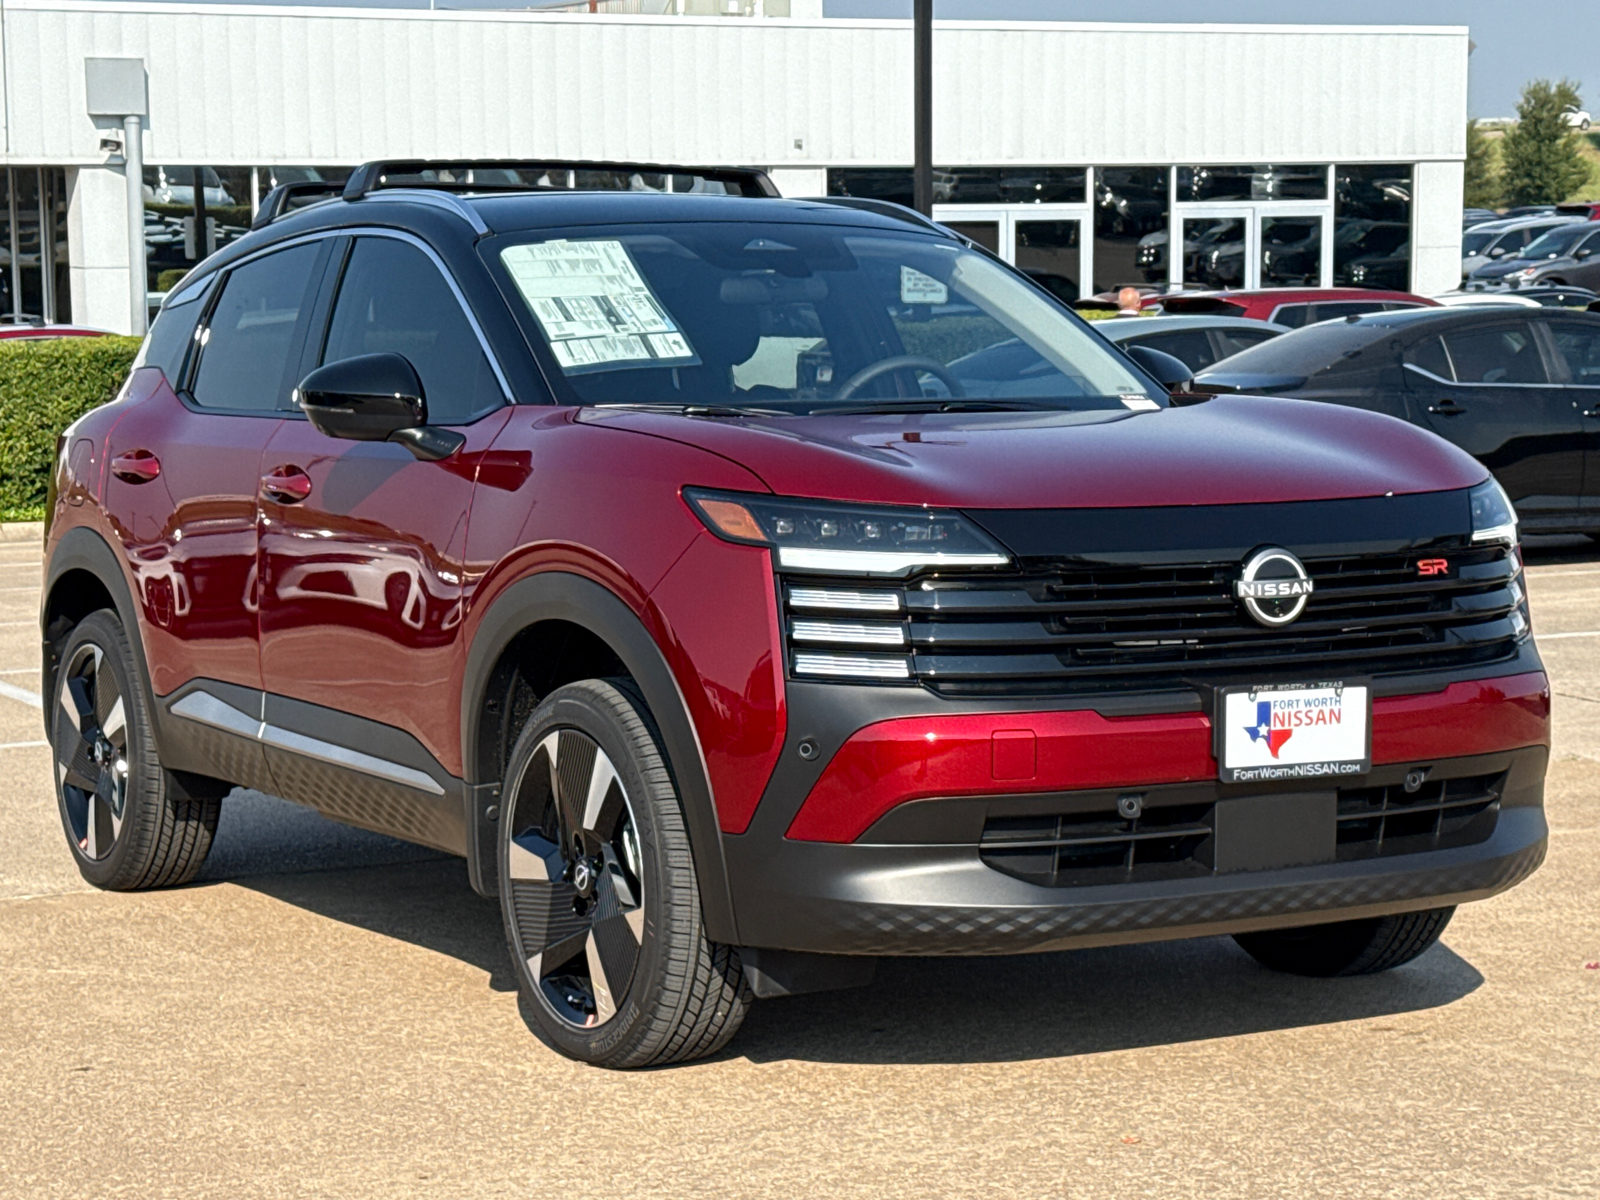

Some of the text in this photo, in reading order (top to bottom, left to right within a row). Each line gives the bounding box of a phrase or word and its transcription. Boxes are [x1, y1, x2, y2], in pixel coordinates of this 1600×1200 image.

[1417, 558, 1449, 576] SR
[1239, 580, 1313, 597] NISSAN
[1252, 681, 1343, 692] FORT WORTH TEXAS
[1273, 696, 1342, 710] FORT WORTH
[1273, 708, 1342, 728] NISSAN
